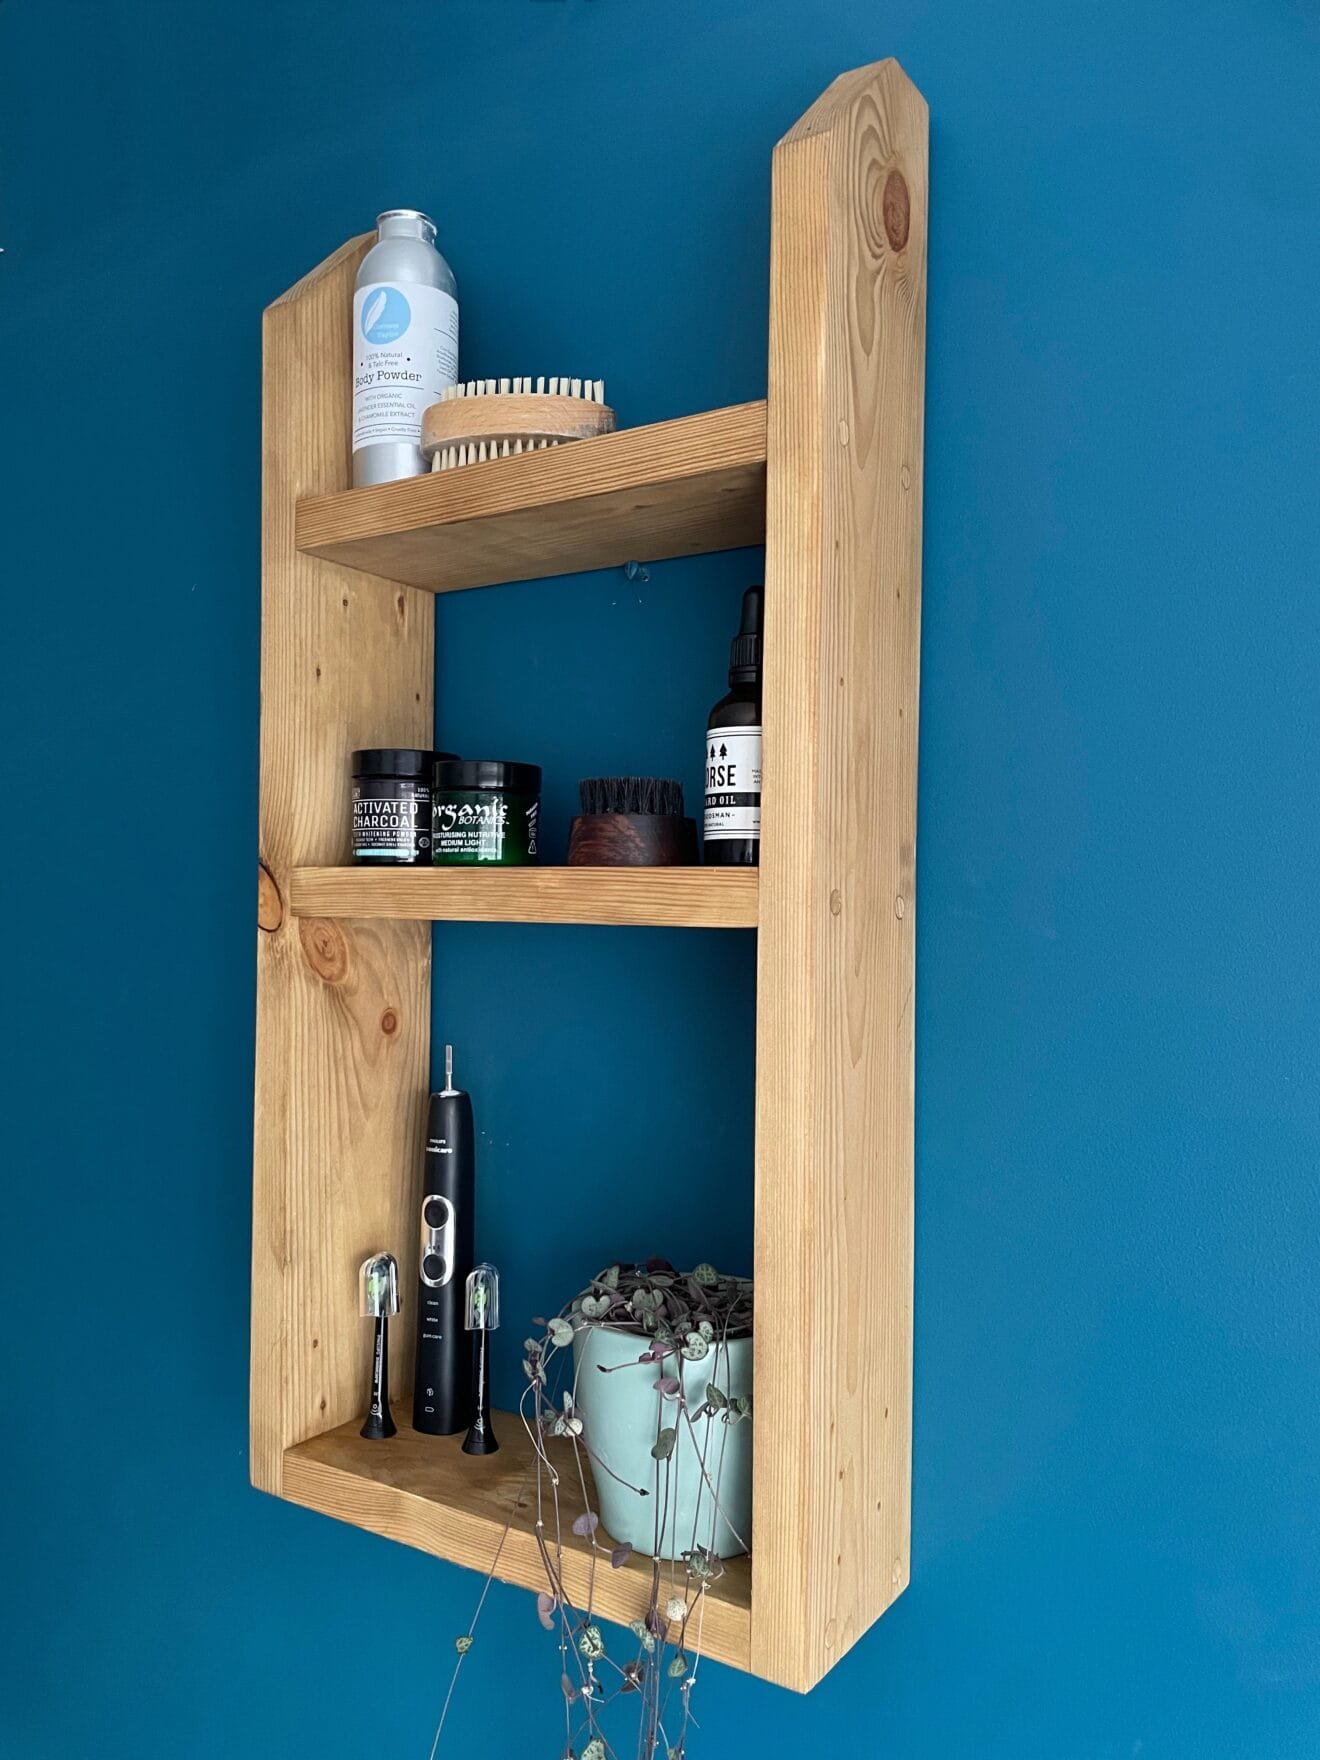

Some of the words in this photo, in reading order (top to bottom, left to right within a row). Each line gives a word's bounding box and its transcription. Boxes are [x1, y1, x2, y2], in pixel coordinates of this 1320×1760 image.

[377, 370, 423, 382] Powder
[719, 795, 737, 805] OIL
[353, 801, 418, 815] ACTIVATED
[353, 815, 419, 828] CHARCOAL
